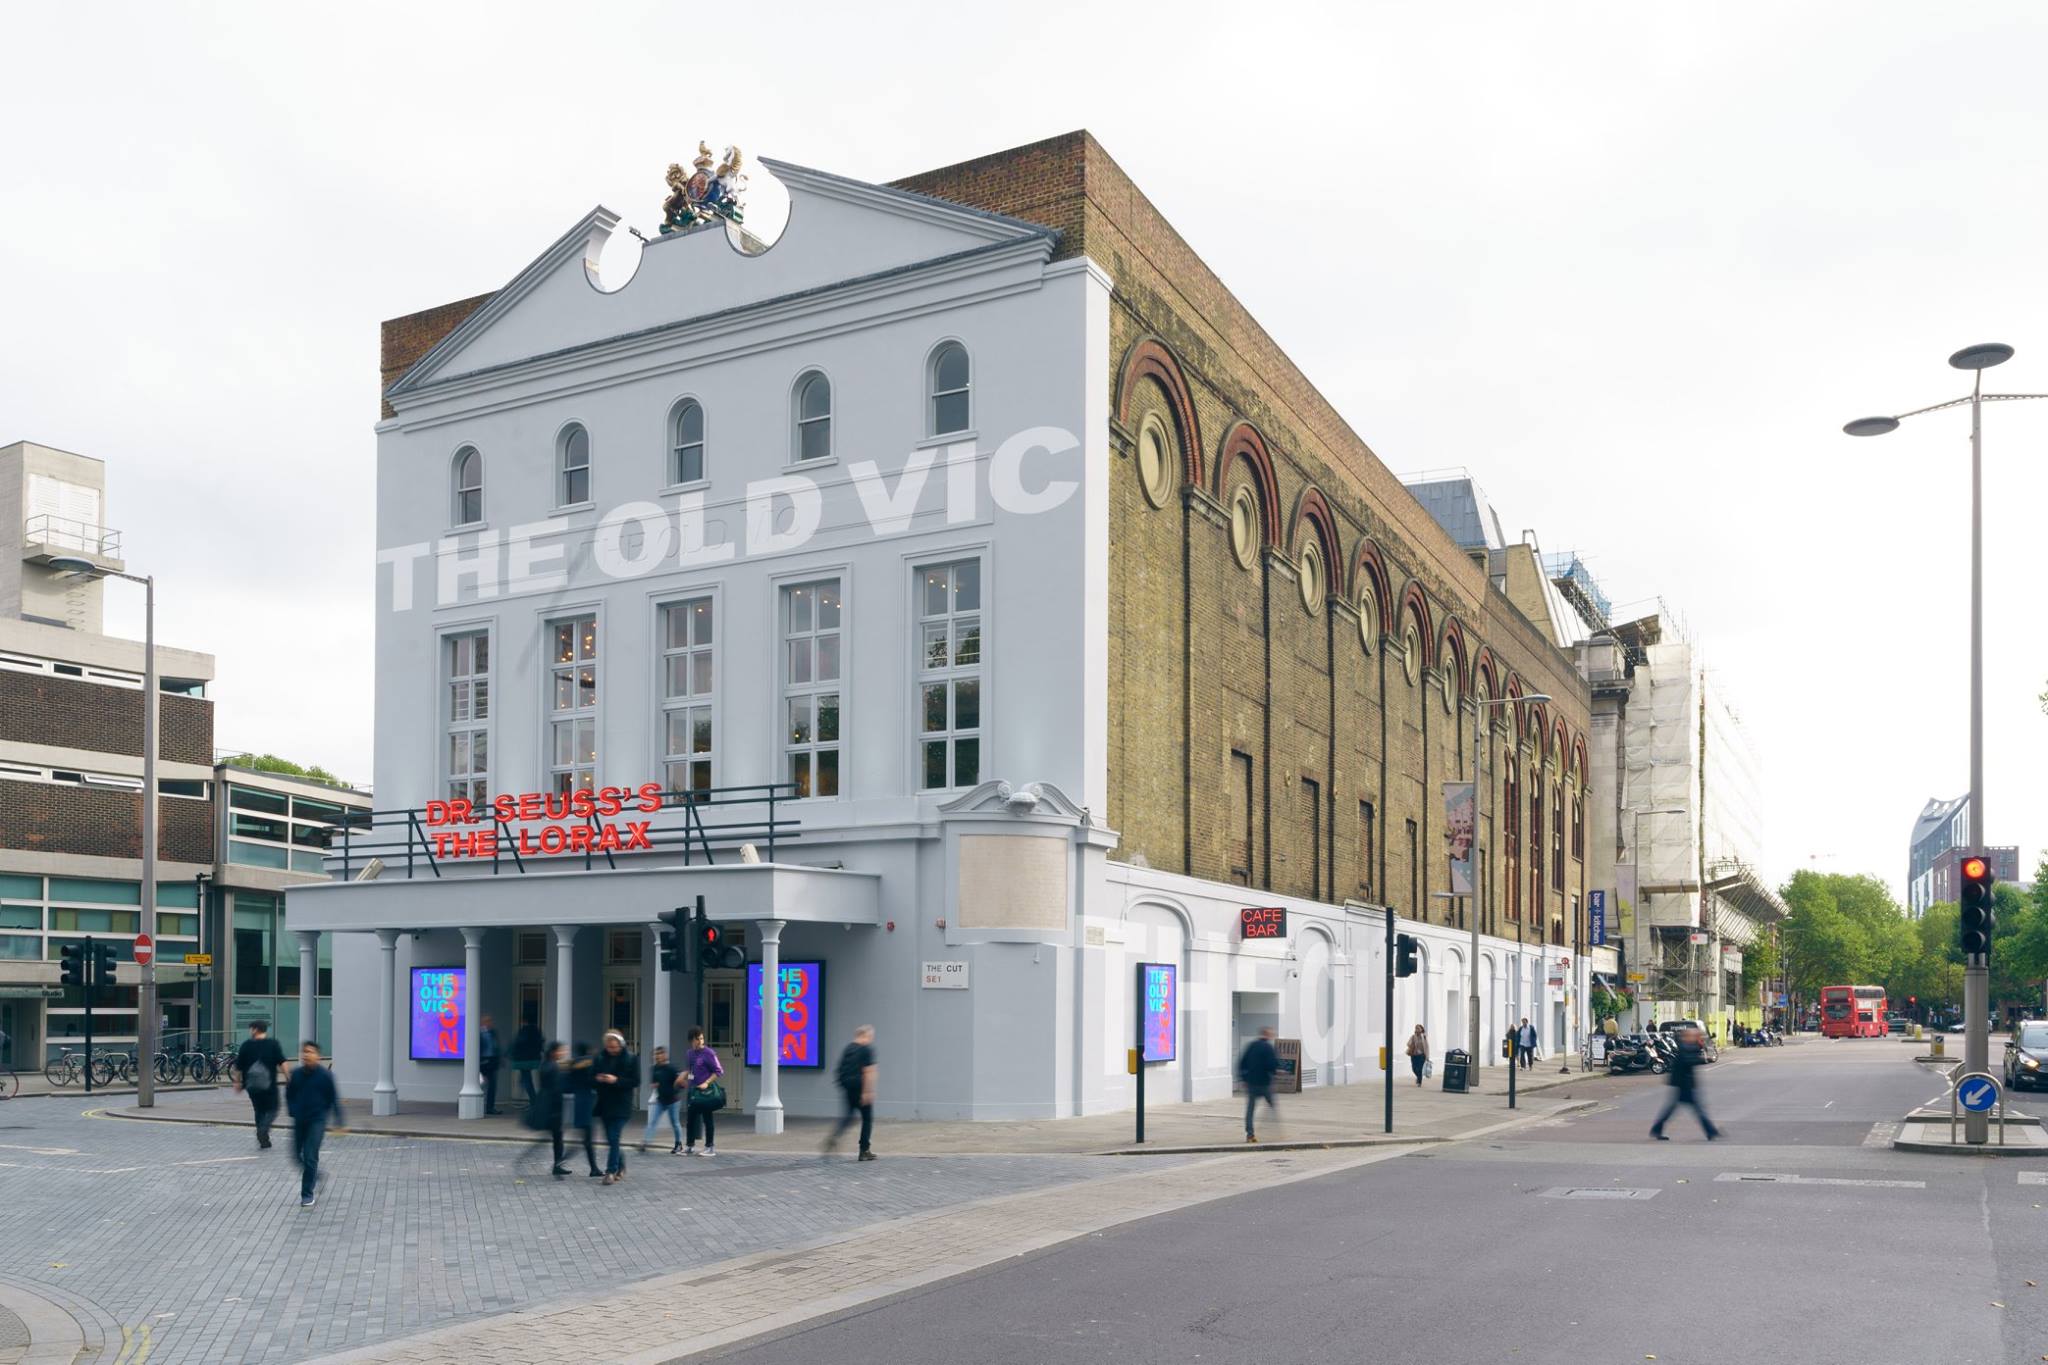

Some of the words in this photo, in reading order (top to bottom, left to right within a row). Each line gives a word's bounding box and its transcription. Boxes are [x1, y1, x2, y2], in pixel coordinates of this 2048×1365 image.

[377, 517, 568, 612] THE
[594, 475, 822, 579] OLD
[848, 426, 1081, 536] VIC
[426, 797, 480, 826] DR.
[495, 783, 663, 823] SEUSS'S
[430, 830, 497, 859] THE
[519, 821, 653, 855] LORAX
[1593, 893, 1601, 907] bar
[1242, 909, 1282, 922] CAFE
[1247, 924, 1278, 937] BAR
[1593, 915, 1601, 944] kitchen
[926, 964, 942, 972] THE
[946, 964, 962, 972] CUT
[420, 972, 453, 986] THE
[1150, 970, 1168, 983] THE
[420, 986, 453, 999] OLD
[1149, 984, 1167, 998] OLD
[420, 1000, 448, 1012] VIC
